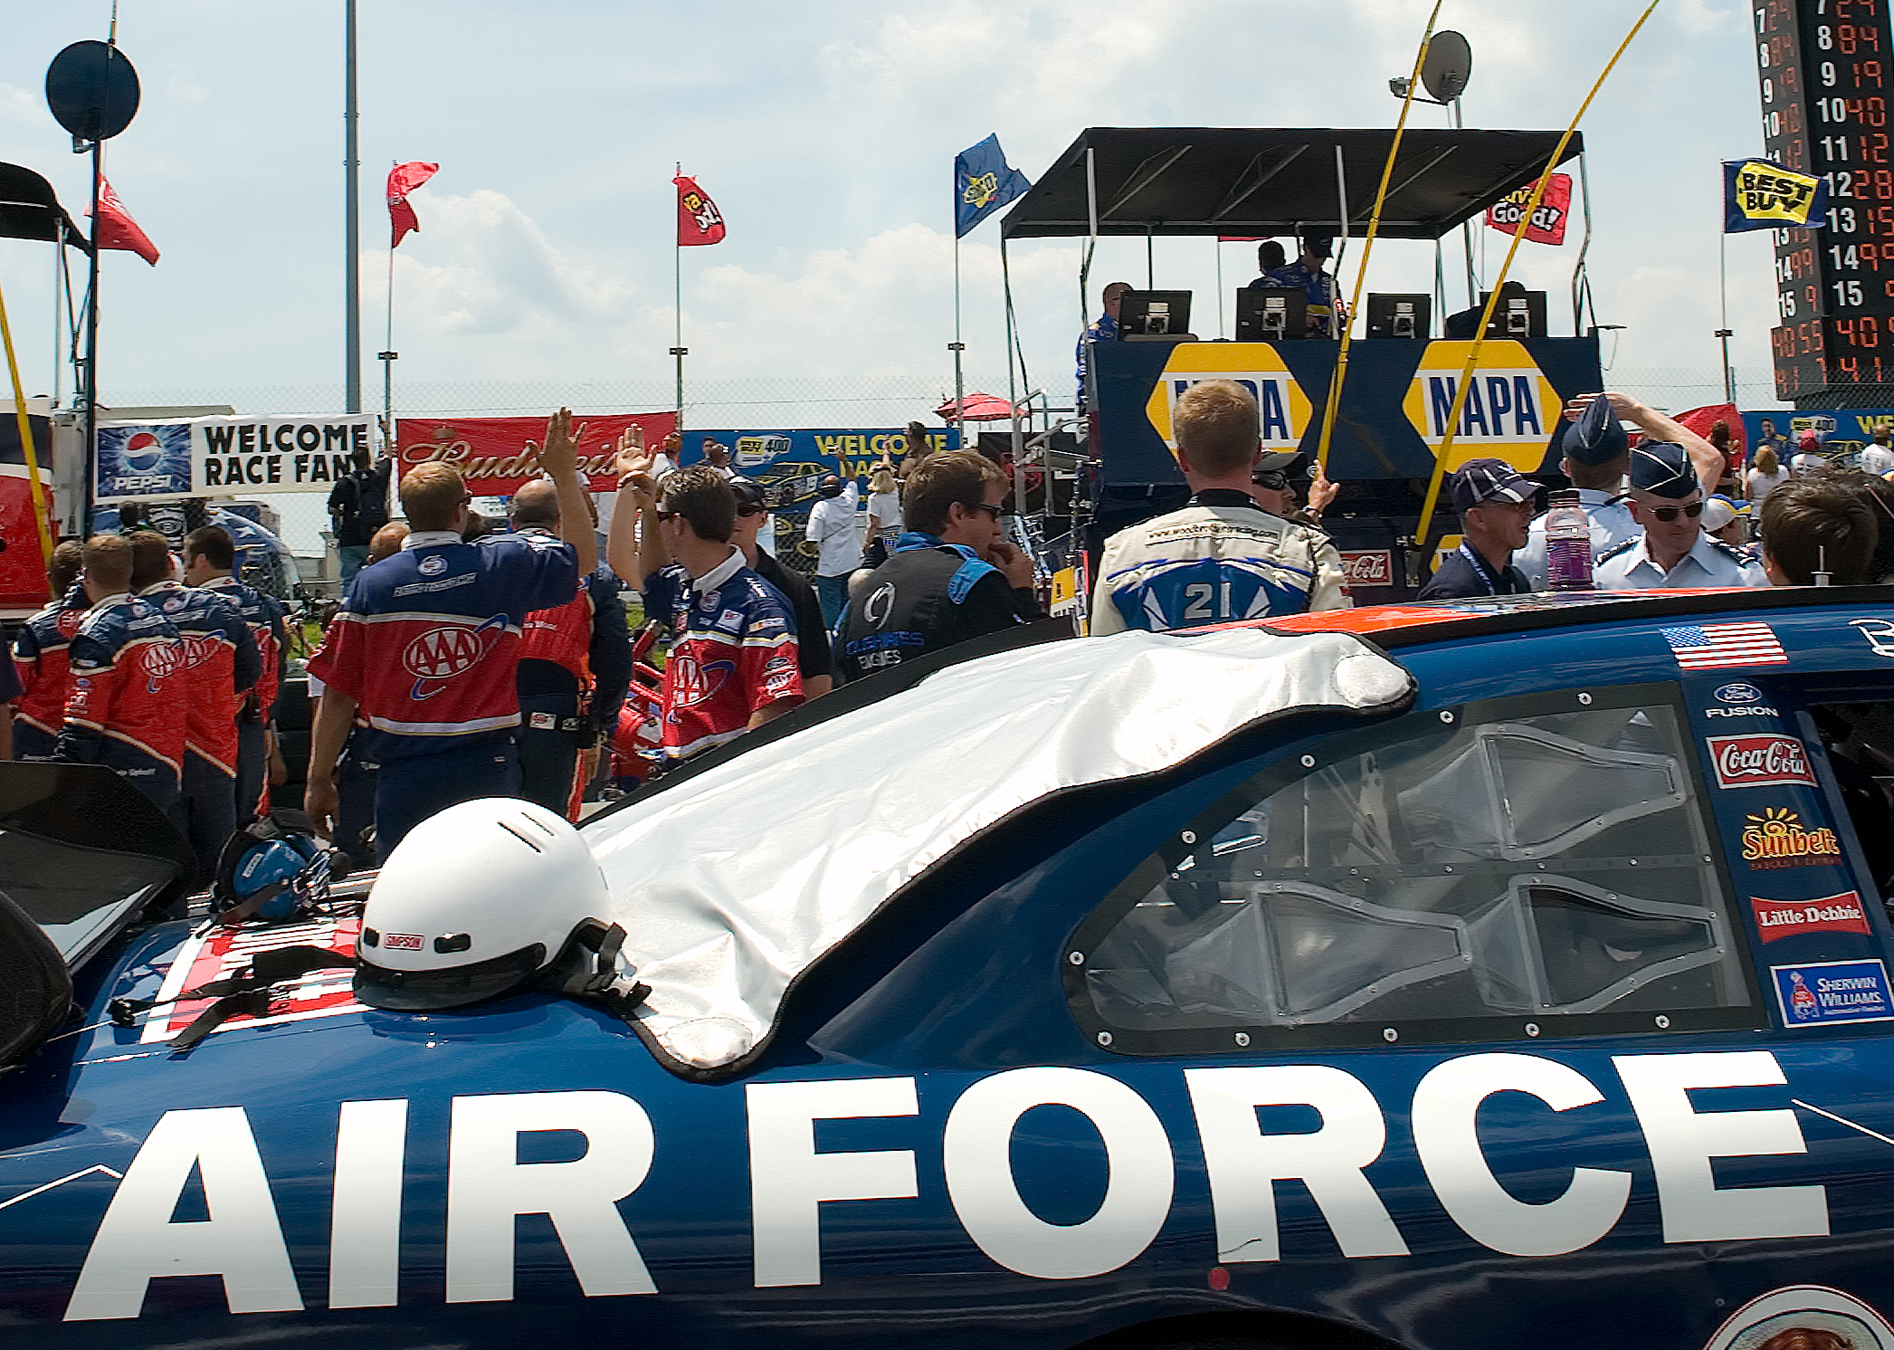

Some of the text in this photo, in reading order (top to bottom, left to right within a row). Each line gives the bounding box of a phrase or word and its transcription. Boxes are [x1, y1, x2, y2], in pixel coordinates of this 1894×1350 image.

[1817, 25, 1833, 50] 8
[1838, 25, 1879, 54] 84
[1760, 42, 1770, 68] 8
[1821, 61, 1837, 87] 9
[1852, 60, 1883, 88] 19
[1763, 78, 1774, 103] 9
[1816, 97, 1846, 123] 10
[1846, 97, 1886, 127] 40
[1762, 111, 1780, 139] 10
[1820, 136, 1848, 161] 11
[1860, 133, 1889, 163] 12
[1742, 172, 1815, 201] BEST
[1822, 171, 1853, 197] 12
[1854, 170, 1892, 200] 28
[1745, 192, 1807, 213] BUY
[1825, 207, 1857, 233] 13
[1867, 206, 1894, 237] 15
[1776, 256, 1793, 283] 14
[1829, 244, 1859, 270] 14
[1779, 290, 1797, 318] 15
[1805, 285, 1818, 312] 9
[1832, 280, 1864, 306] 15
[1836, 316, 1879, 347] 40
[1840, 356, 1883, 383] 41
[1429, 375, 1542, 438] NAPA
[204, 423, 369, 455] WELCOME
[113, 474, 172, 491] PEPSI
[205, 454, 282, 486] RACE
[1184, 582, 1231, 619] 21
[409, 628, 477, 677] AAA
[1723, 685, 1754, 700] Ford
[1705, 706, 1780, 719] FUSION
[1720, 740, 1806, 778] Coca-Cola
[1742, 827, 1841, 861] Sunbelt
[1759, 904, 1862, 928] Little Debbie
[1817, 976, 1878, 993] SHERWIN
[63, 1050, 1831, 1323] AIR FORCE
